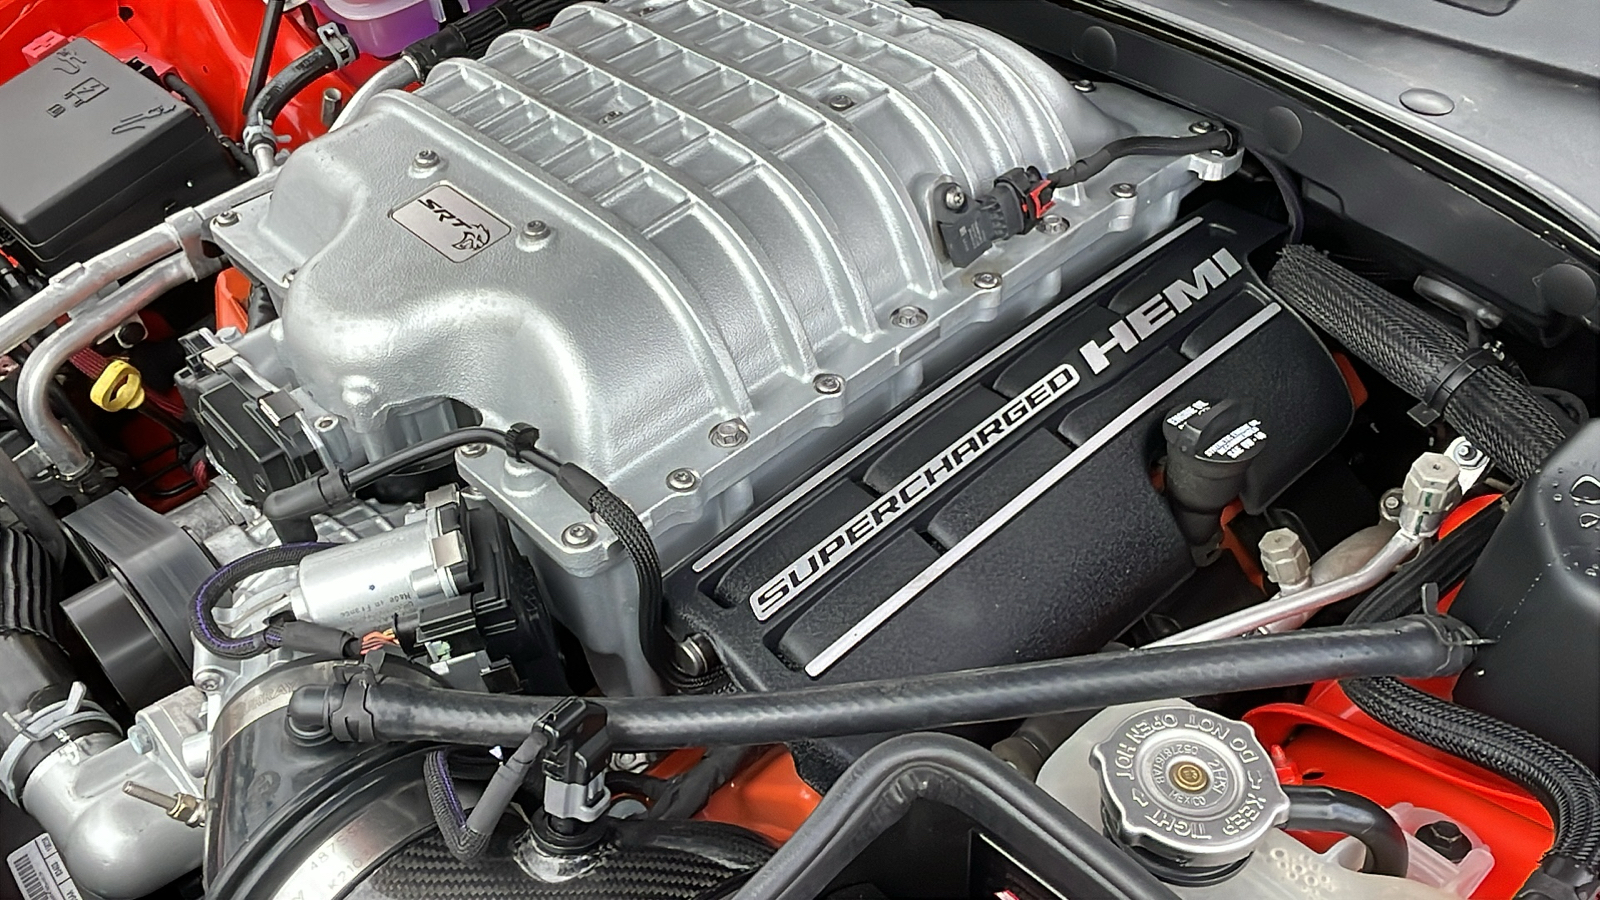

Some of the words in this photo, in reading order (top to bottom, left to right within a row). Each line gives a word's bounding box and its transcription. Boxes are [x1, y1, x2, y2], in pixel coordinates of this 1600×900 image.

[417, 199, 472, 229] SRT
[754, 366, 1076, 615] SUPERCHARGED
[1079, 247, 1243, 375] HEMI
[1126, 713, 1179, 744] OPEN
[1184, 714, 1231, 741] NOT
[1115, 743, 1137, 780] HOT
[1229, 738, 1260, 764] DO
[1168, 790, 1207, 807] MEXICO
[1222, 792, 1267, 836] KEEP
[1144, 809, 1212, 840] TIGHT
